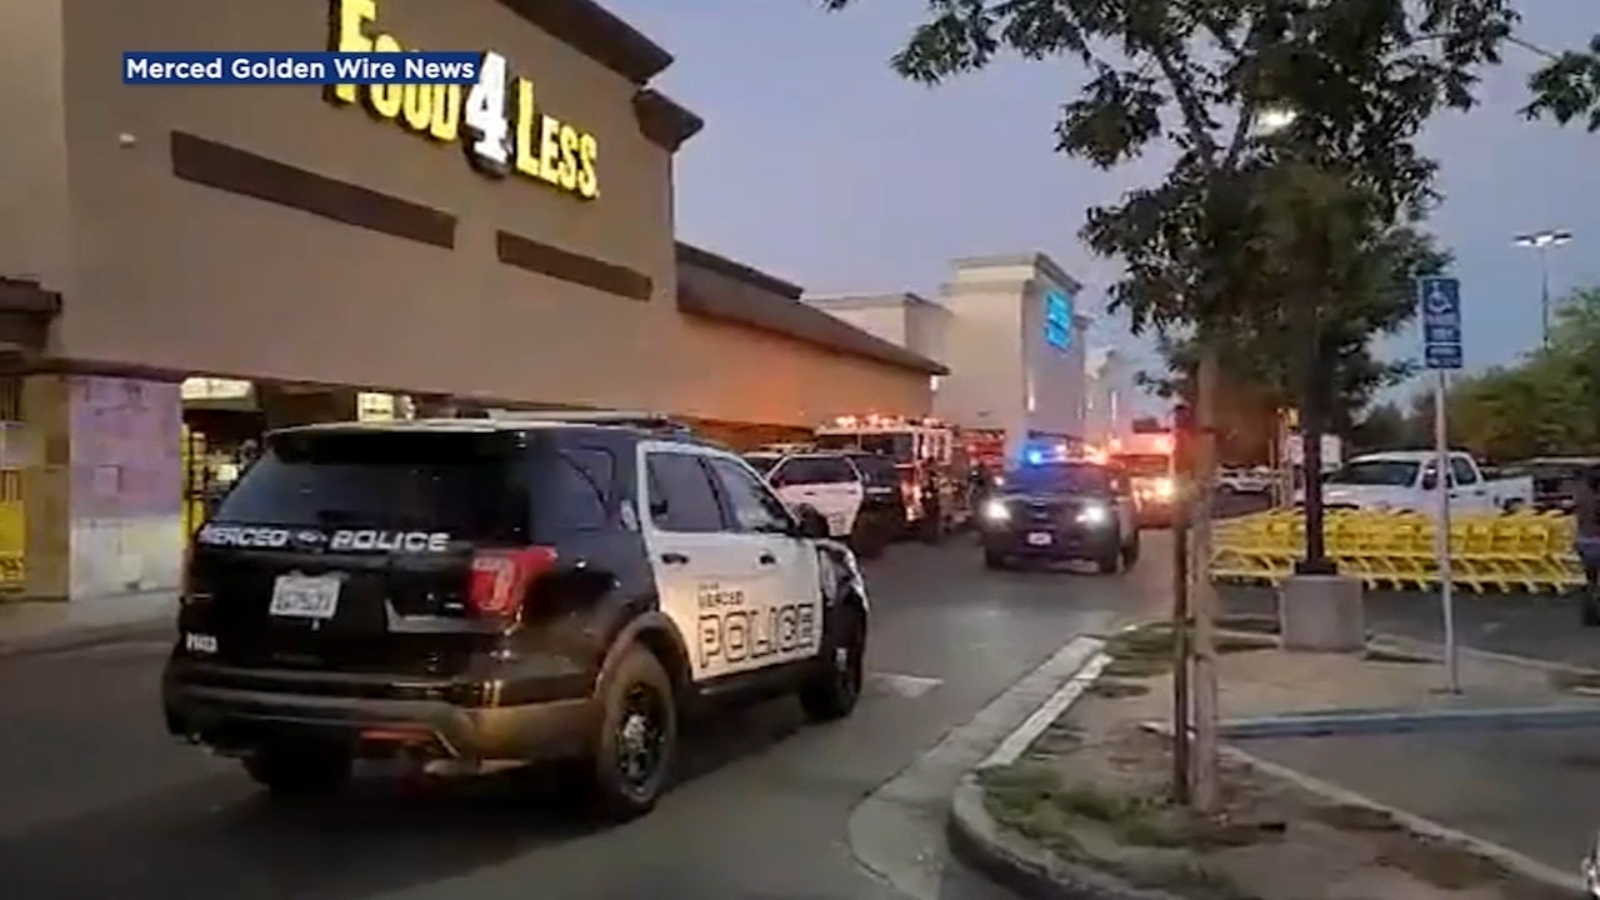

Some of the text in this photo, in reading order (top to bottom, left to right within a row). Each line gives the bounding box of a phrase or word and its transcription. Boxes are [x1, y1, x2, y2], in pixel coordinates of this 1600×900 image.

[465, 50, 507, 165] 4
[330, 530, 449, 550] POLICE
[699, 604, 814, 668] POLICE
